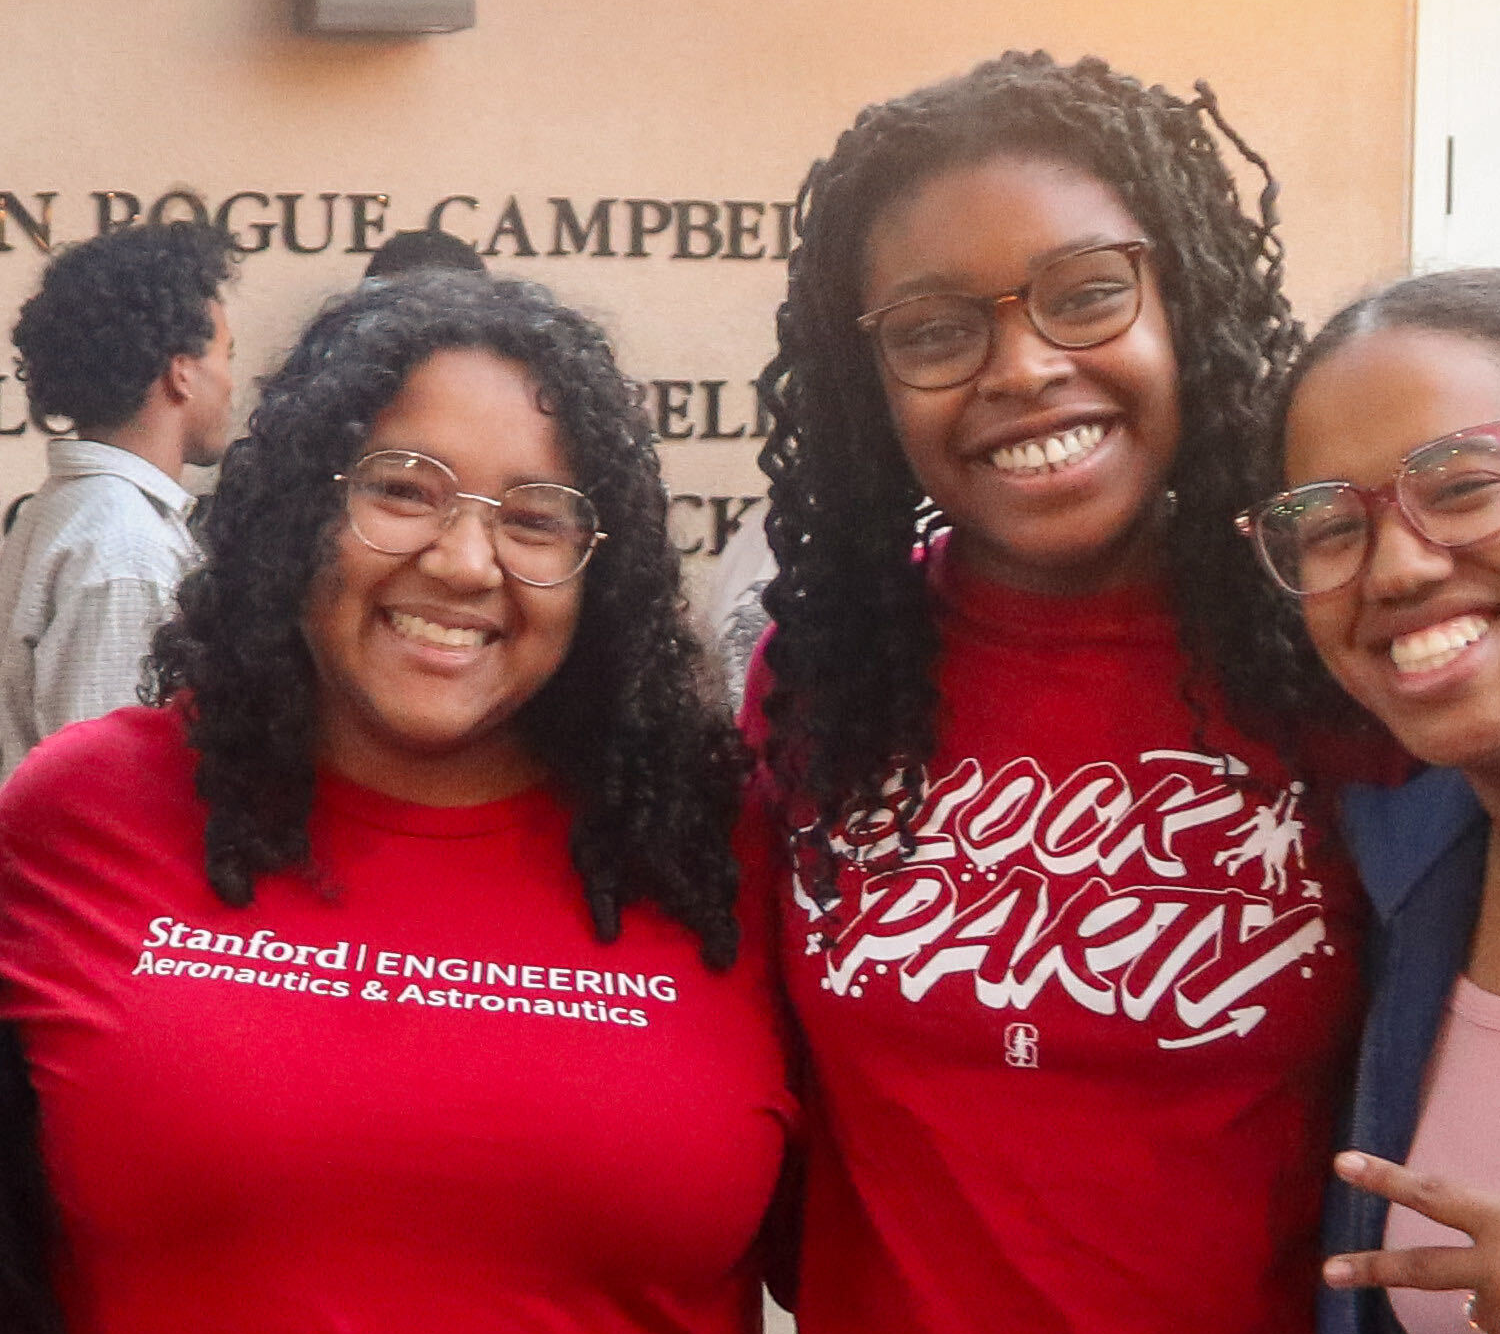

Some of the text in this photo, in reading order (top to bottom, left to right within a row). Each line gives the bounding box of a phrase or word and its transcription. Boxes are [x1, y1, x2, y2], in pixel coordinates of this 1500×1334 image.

[425, 193, 798, 260] CAMPBEL
[143, 916, 679, 1003] Stanford ENGINEERING
[826, 865, 1326, 1029] PARTY
[131, 950, 649, 1027] Aeronautics & Astronautics
